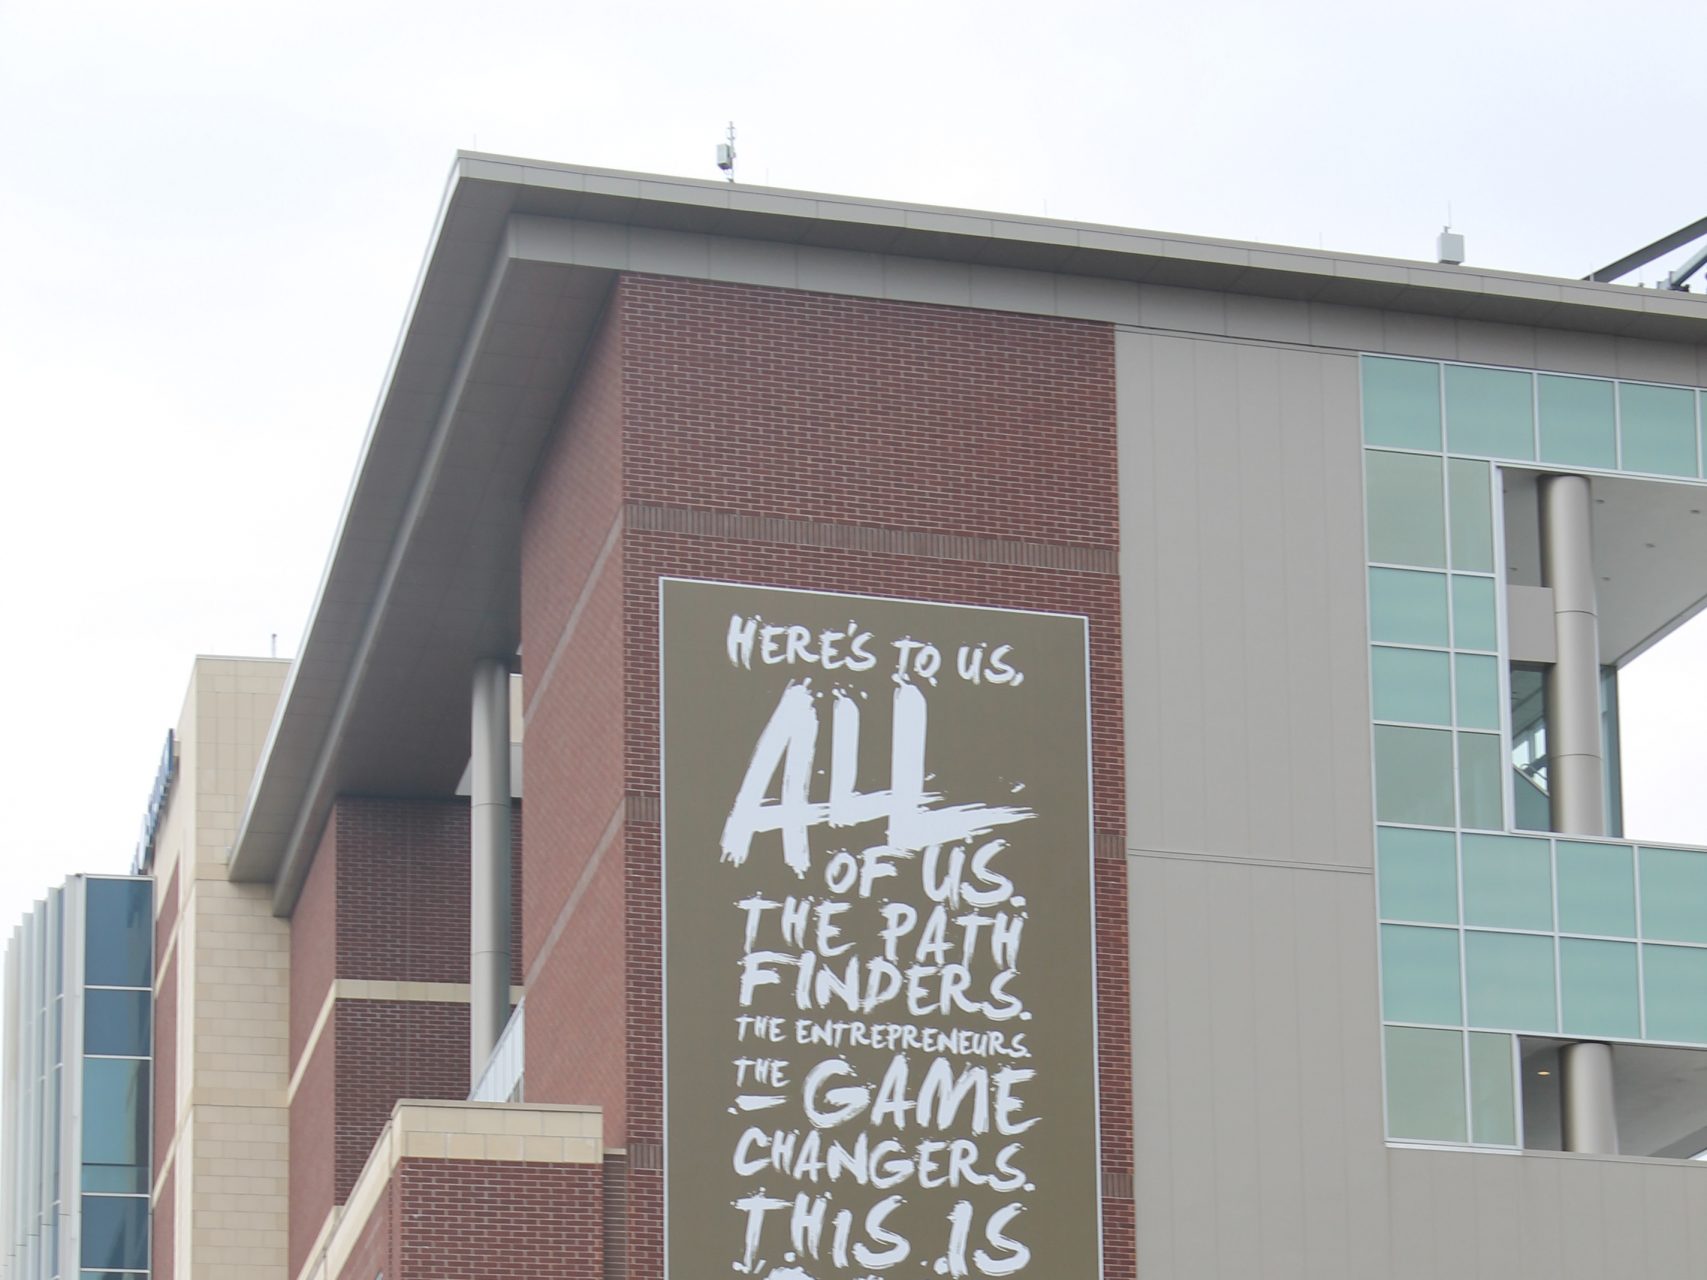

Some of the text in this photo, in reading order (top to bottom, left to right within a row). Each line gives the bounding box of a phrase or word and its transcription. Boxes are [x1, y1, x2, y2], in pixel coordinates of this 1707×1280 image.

[727, 614, 877, 671] HERE'S
[891, 637, 942, 684] TO
[720, 680, 1038, 878] ALL
[825, 839, 1026, 911] OF US.
[734, 895, 1028, 970] THE PATH
[737, 951, 1032, 1022] FINDERS.
[735, 1015, 1032, 1058] THE ENTREPRENEURS.
[733, 1053, 1043, 1136] THE GAME
[733, 1127, 1036, 1192] CHANGERS.
[732, 1191, 1031, 1278] THIS IS
